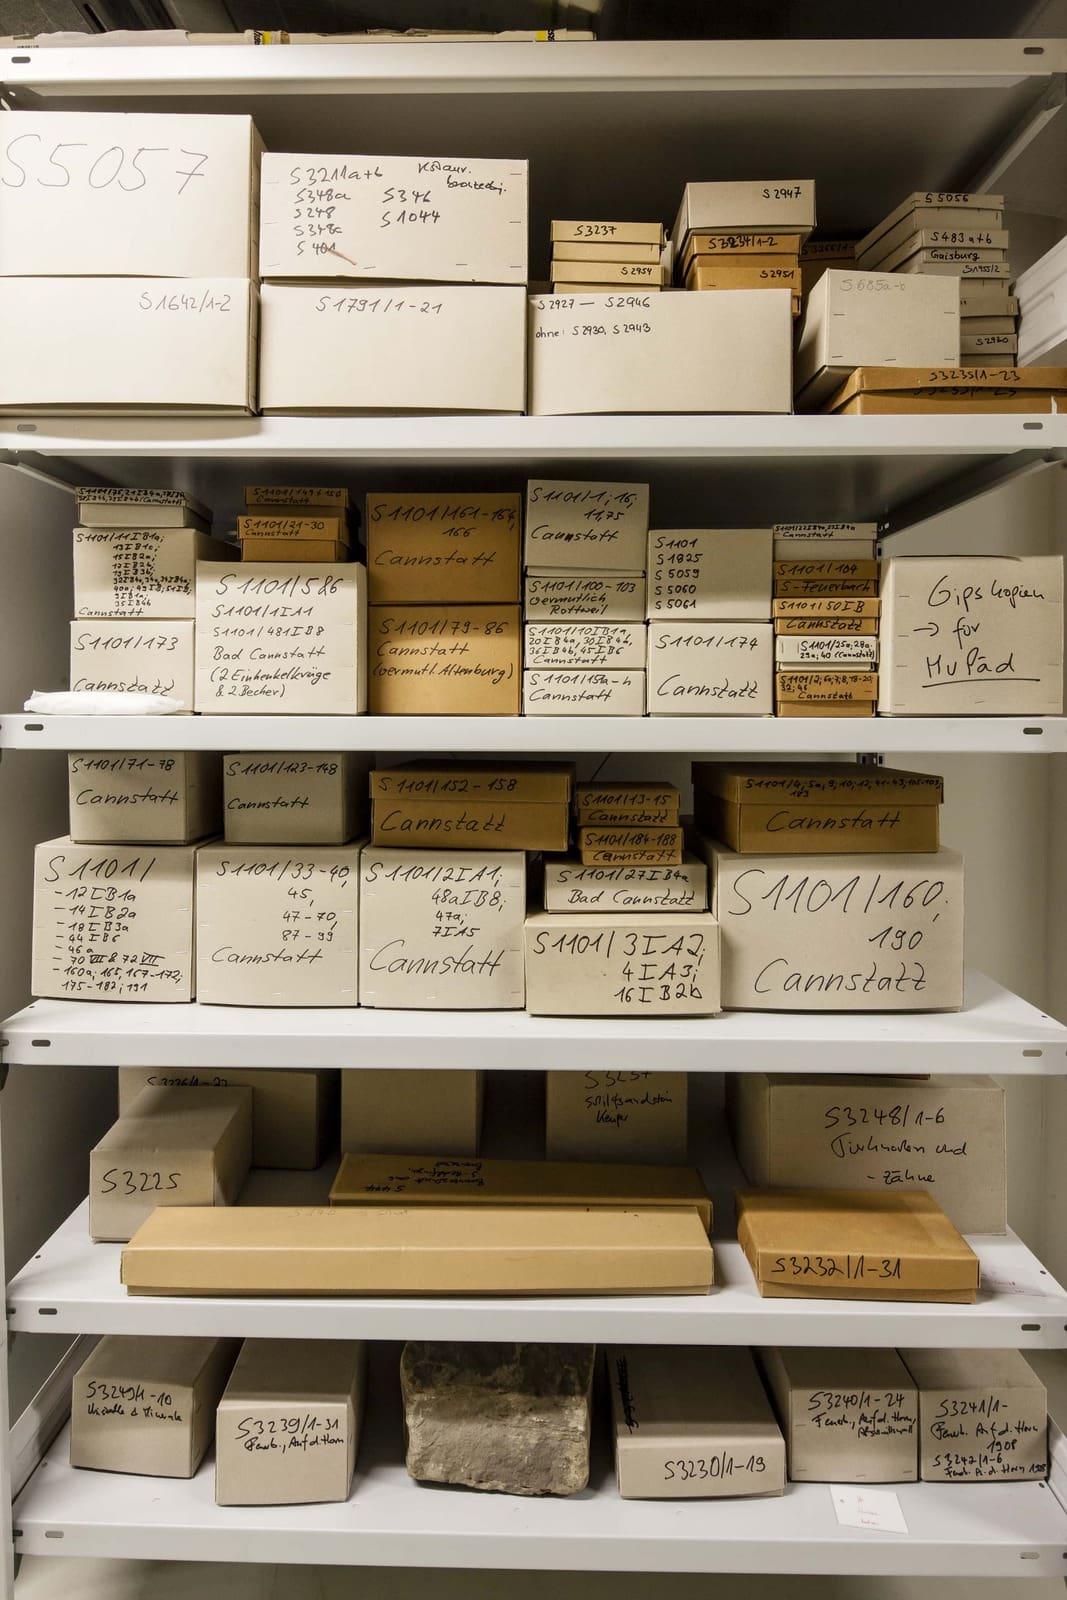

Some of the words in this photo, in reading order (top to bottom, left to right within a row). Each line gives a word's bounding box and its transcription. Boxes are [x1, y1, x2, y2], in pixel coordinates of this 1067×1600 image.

[1, 134, 209, 194] S5057
[930, 250, 980, 262] Gaisburg
[442, 527, 477, 538] 166
[375, 550, 497, 566] Cannstatt
[550, 604, 608, 615] Rottweil
[786, 617, 863, 631] Cannstatt
[213, 646, 240, 661] Bad
[249, 646, 326, 660] Cannstatt
[376, 641, 470, 657] Cannstatt
[533, 655, 607, 665] Cannstatt
[657, 674, 758, 698] Cannstatt
[529, 688, 613, 701] Cannstatt
[75, 787, 179, 806] Cannstatt
[227, 796, 309, 810] Cannstatt
[380, 810, 506, 832] Cannstatt
[588, 809, 668, 823] Cannstatt
[766, 809, 901, 832] Cannstatt
[592, 850, 676, 861] Cannstatt
[567, 889, 604, 904] Bad
[613, 888, 695, 905] Cannstatt
[868, 926, 923, 950] 190
[211, 947, 323, 964] Cannstatt
[369, 940, 505, 976] Cannstatt
[754, 958, 926, 993] Cannstatt
[935, 1142, 967, 1156] und
[101, 1168, 181, 1195] S3225
[771, 1254, 902, 1279] S3232/1-31
[664, 1451, 766, 1480] S3230/1-19
